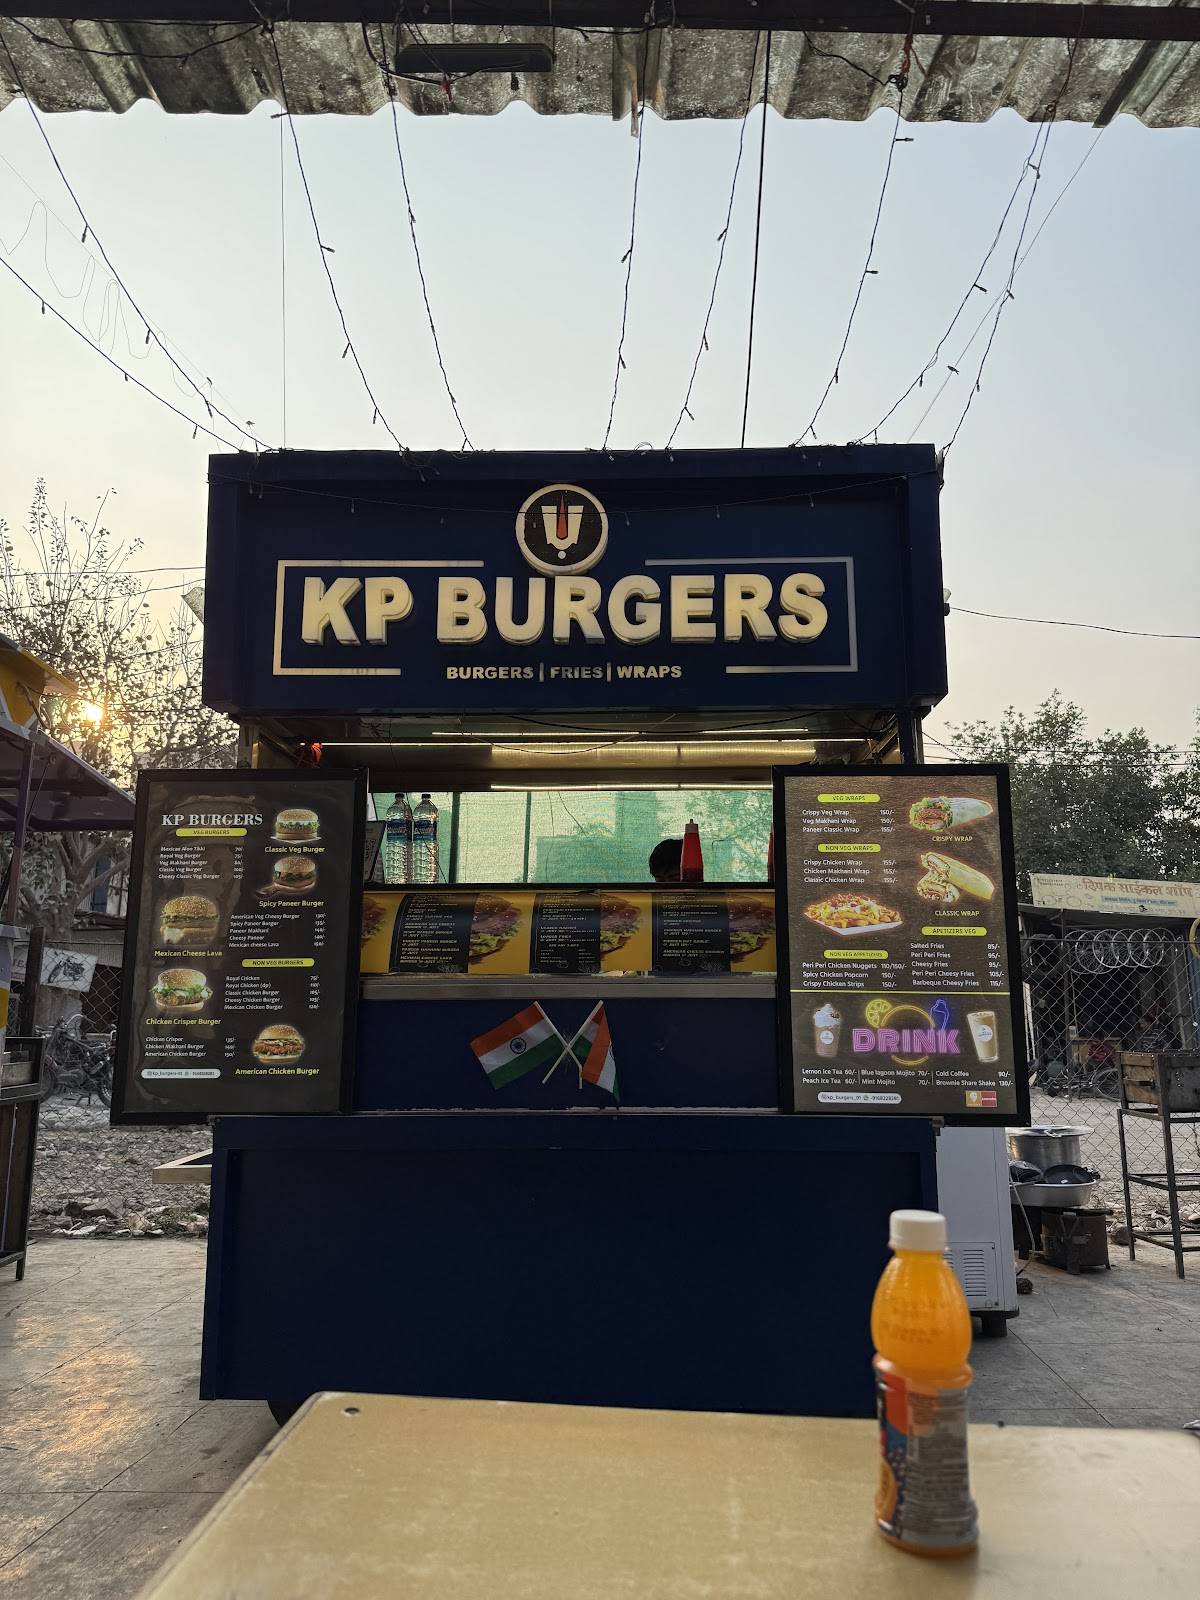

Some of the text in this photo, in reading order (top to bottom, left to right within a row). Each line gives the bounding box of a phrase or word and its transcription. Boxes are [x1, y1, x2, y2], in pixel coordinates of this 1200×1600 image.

[301, 573, 828, 646] KP BURGERS
[446, 665, 683, 680] BURGERS FRIES WRAPS
[802, 809, 820, 817] Crispy
[821, 809, 833, 817] Veg
[161, 813, 263, 826] KP BURGERS
[843, 826, 860, 834] Wrap
[289, 846, 302, 854] Veg
[302, 846, 325, 854] Burger
[803, 859, 822, 867] Crispy
[846, 859, 863, 867] Wrap
[259, 900, 278, 908] Spicy
[301, 900, 325, 908] Burger
[852, 962, 877, 970] Nuggets
[802, 971, 819, 979] Spicy
[844, 971, 869, 979] Popcorn
[937, 970, 960, 978] Cheesy
[803, 980, 822, 988] Crispy
[847, 981, 865, 989] Strips
[912, 979, 942, 987] Barbeque
[173, 1018, 197, 1027] Crisper
[198, 1018, 222, 1027] Burger
[852, 1028, 961, 1054] DRINK
[187, 1043, 205, 1051] Burger
[296, 1068, 321, 1076] Burger
[875, 1069, 895, 1077] lagoon
[876, 1078, 896, 1086] Mojito
